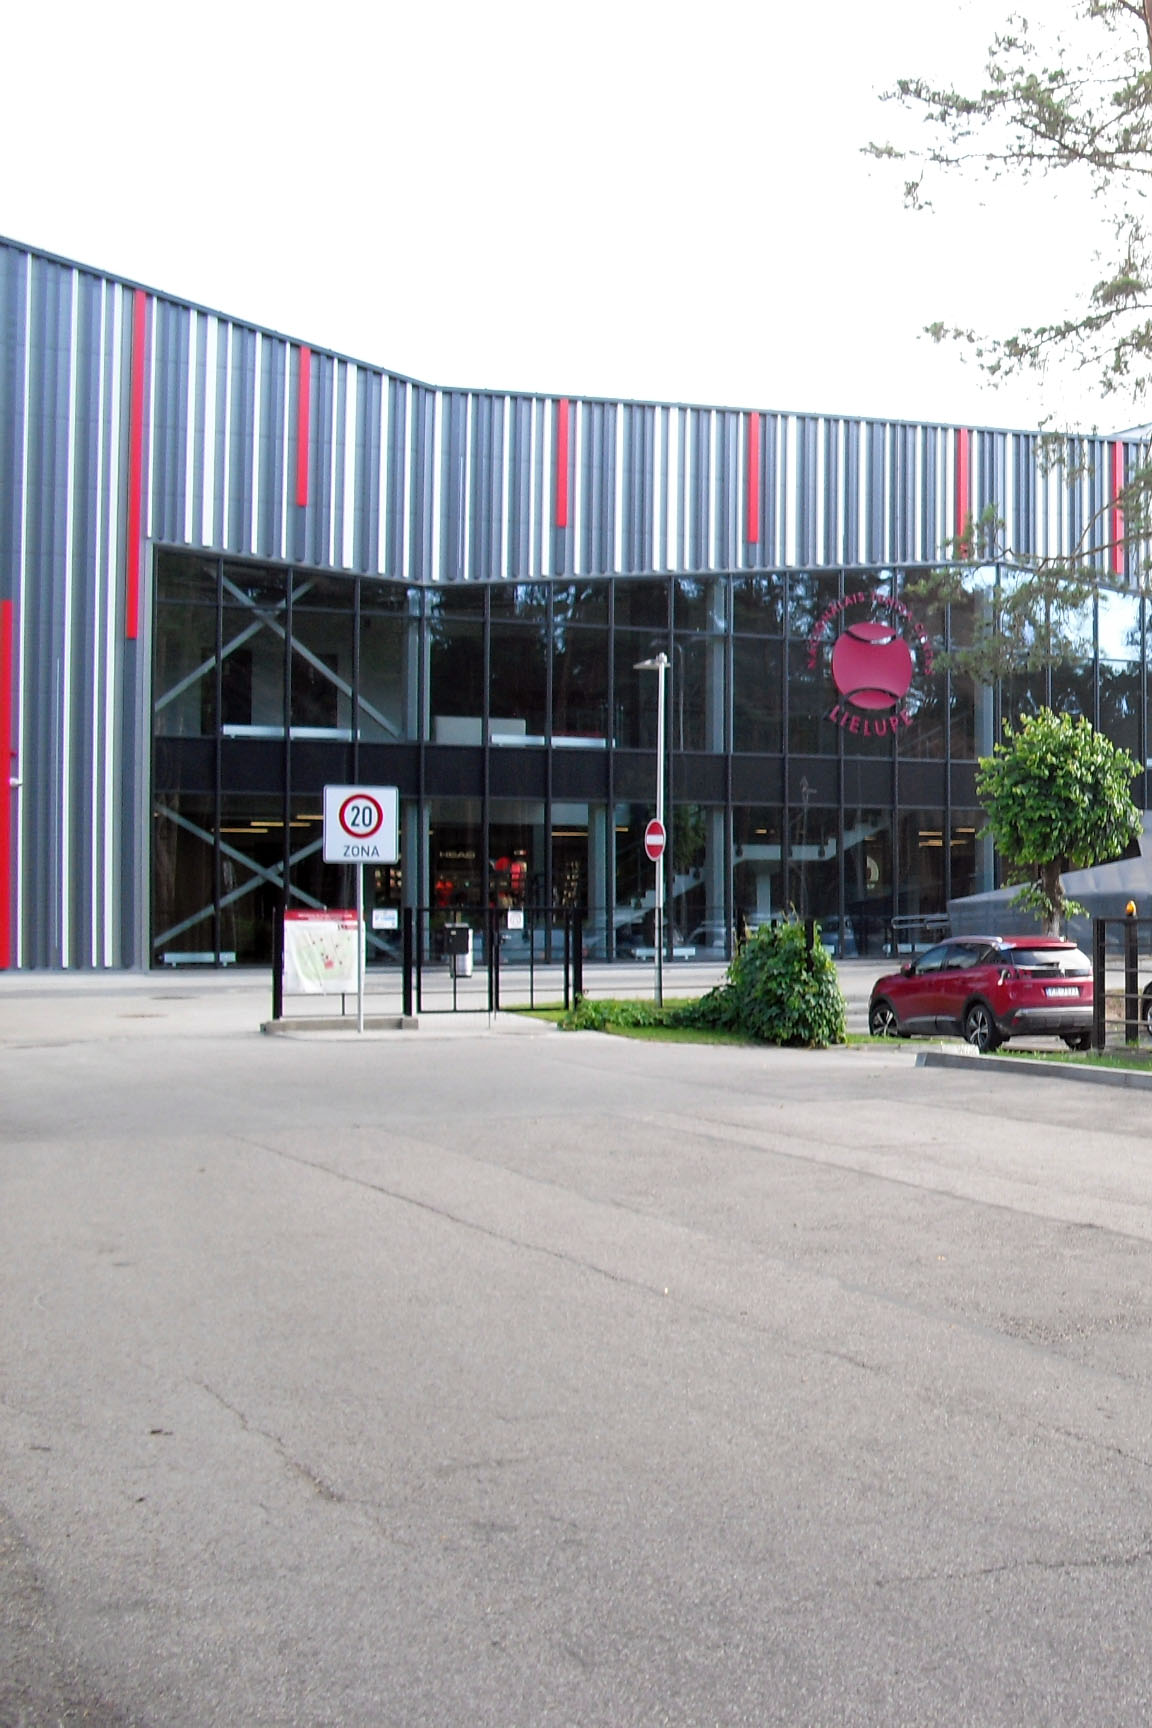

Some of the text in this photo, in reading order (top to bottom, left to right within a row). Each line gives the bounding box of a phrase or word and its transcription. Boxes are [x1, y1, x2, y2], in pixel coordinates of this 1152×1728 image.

[830, 705, 913, 736] LIELUPE
[350, 805, 373, 828] 20
[343, 845, 380, 857] ZONA
